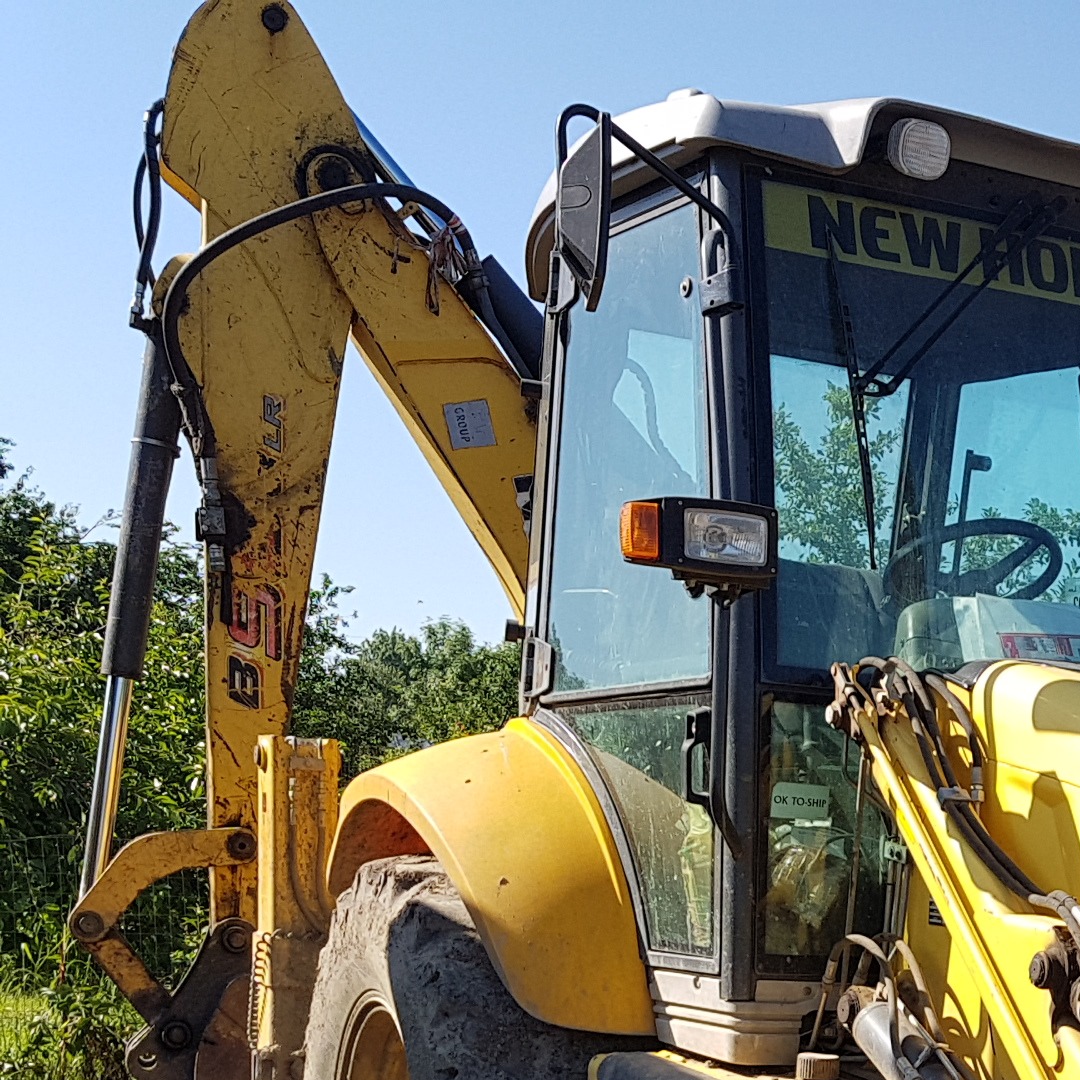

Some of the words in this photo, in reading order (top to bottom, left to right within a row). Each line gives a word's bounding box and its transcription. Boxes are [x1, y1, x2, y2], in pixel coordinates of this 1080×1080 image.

[807, 194, 961, 274] NEW
[773, 795, 788, 806] OK
[791, 796, 827, 808] TO-SHIP
